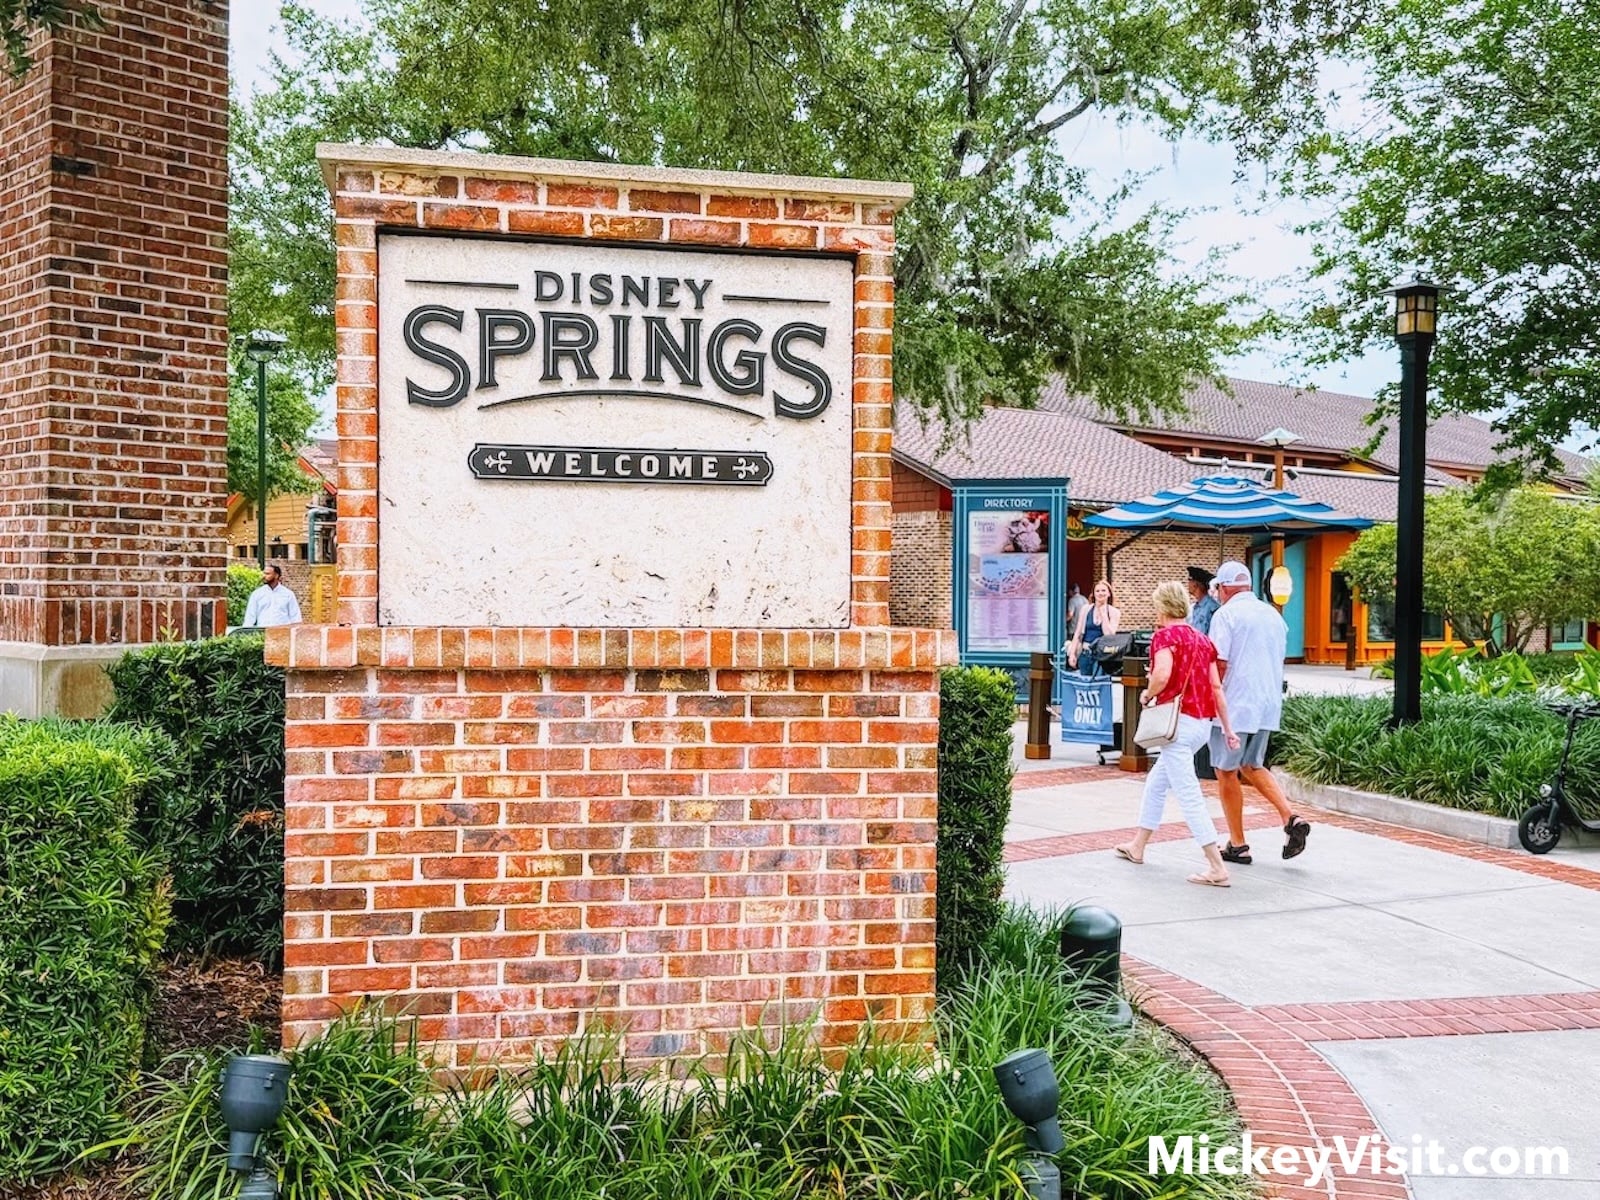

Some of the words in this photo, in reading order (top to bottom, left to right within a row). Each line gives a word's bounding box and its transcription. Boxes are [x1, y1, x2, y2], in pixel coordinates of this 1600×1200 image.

[534, 270, 713, 310] DISNEY
[403, 304, 833, 422] SPRINGS
[525, 451, 720, 478] WELCOME
[984, 498, 1034, 508] DIRECTORY
[1075, 690, 1100, 706] EXIT
[1073, 707, 1103, 724] ONLY
